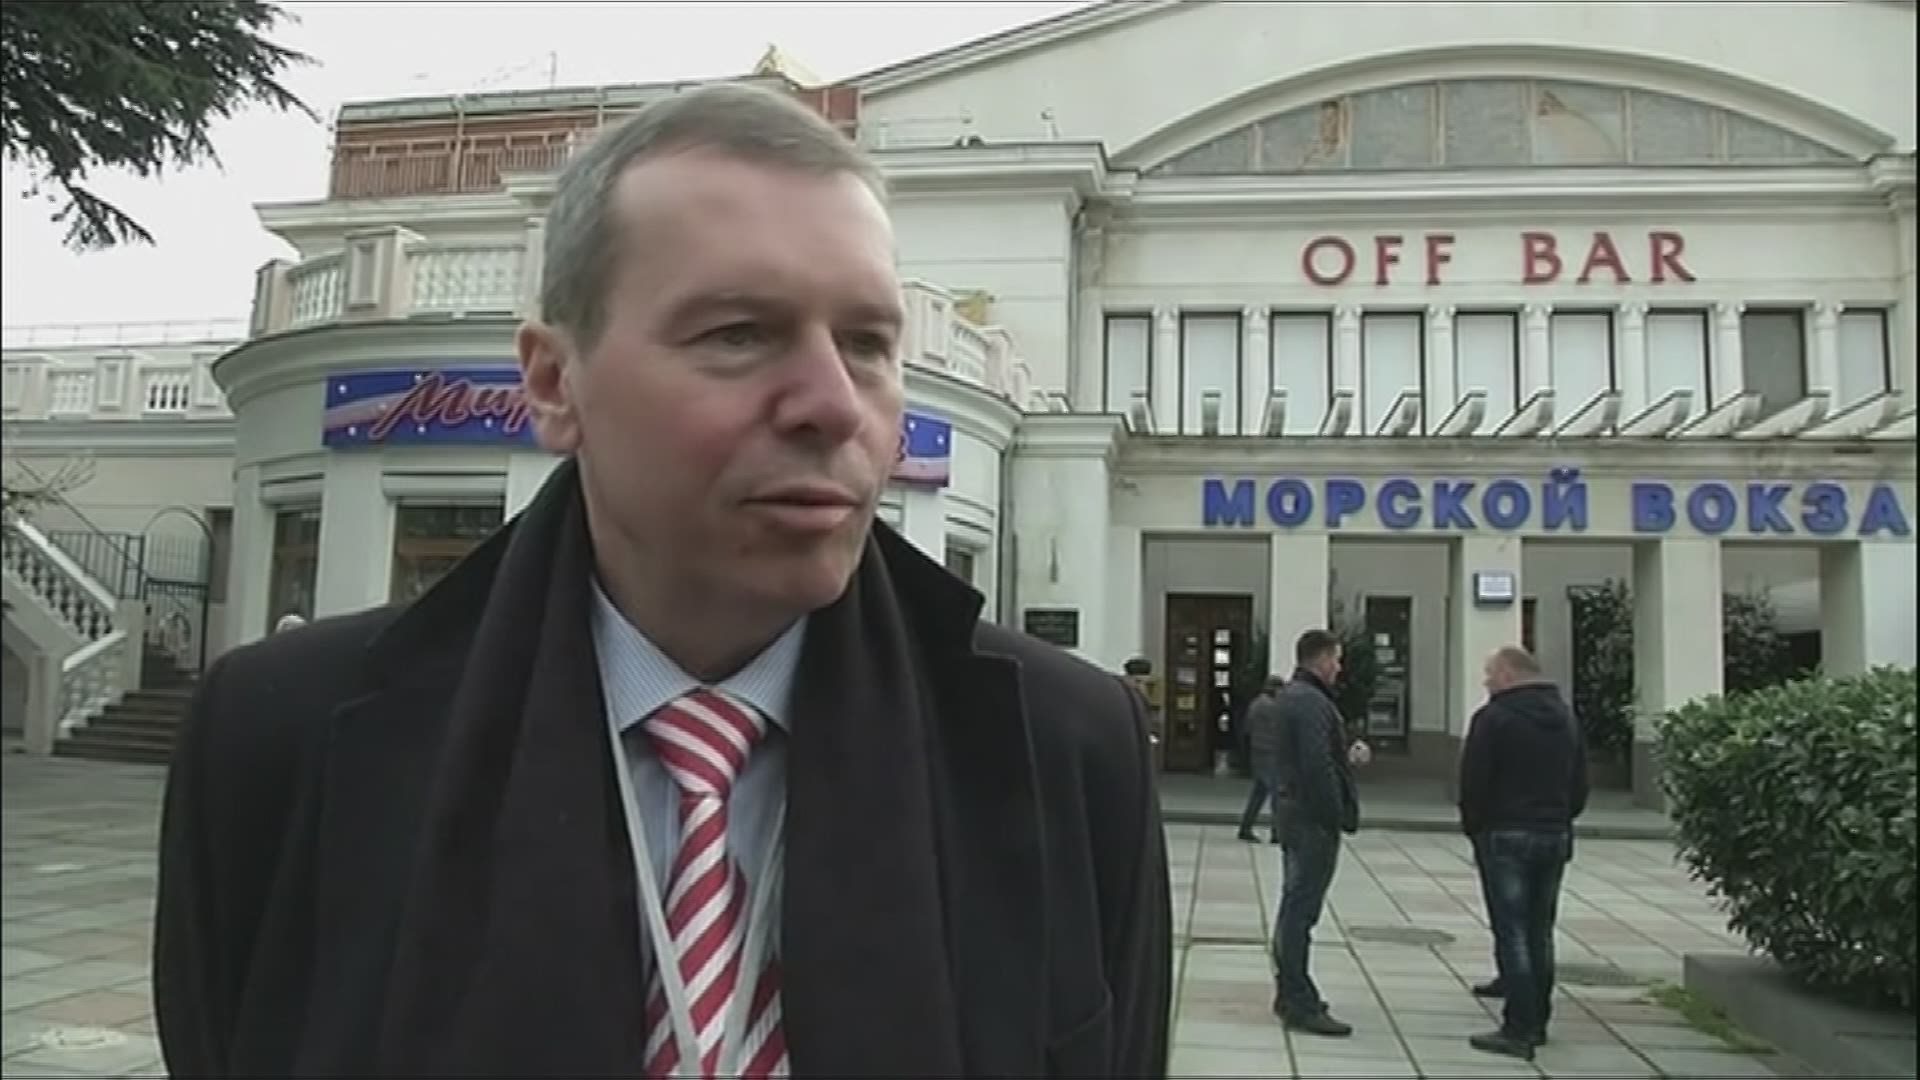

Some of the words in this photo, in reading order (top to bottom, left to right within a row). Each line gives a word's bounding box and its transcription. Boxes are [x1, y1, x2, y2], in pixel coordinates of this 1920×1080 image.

[1302, 234, 1455, 287] OFF
[1520, 231, 1697, 285] BAR
[1202, 468, 1589, 531] МОРСКОЙ
